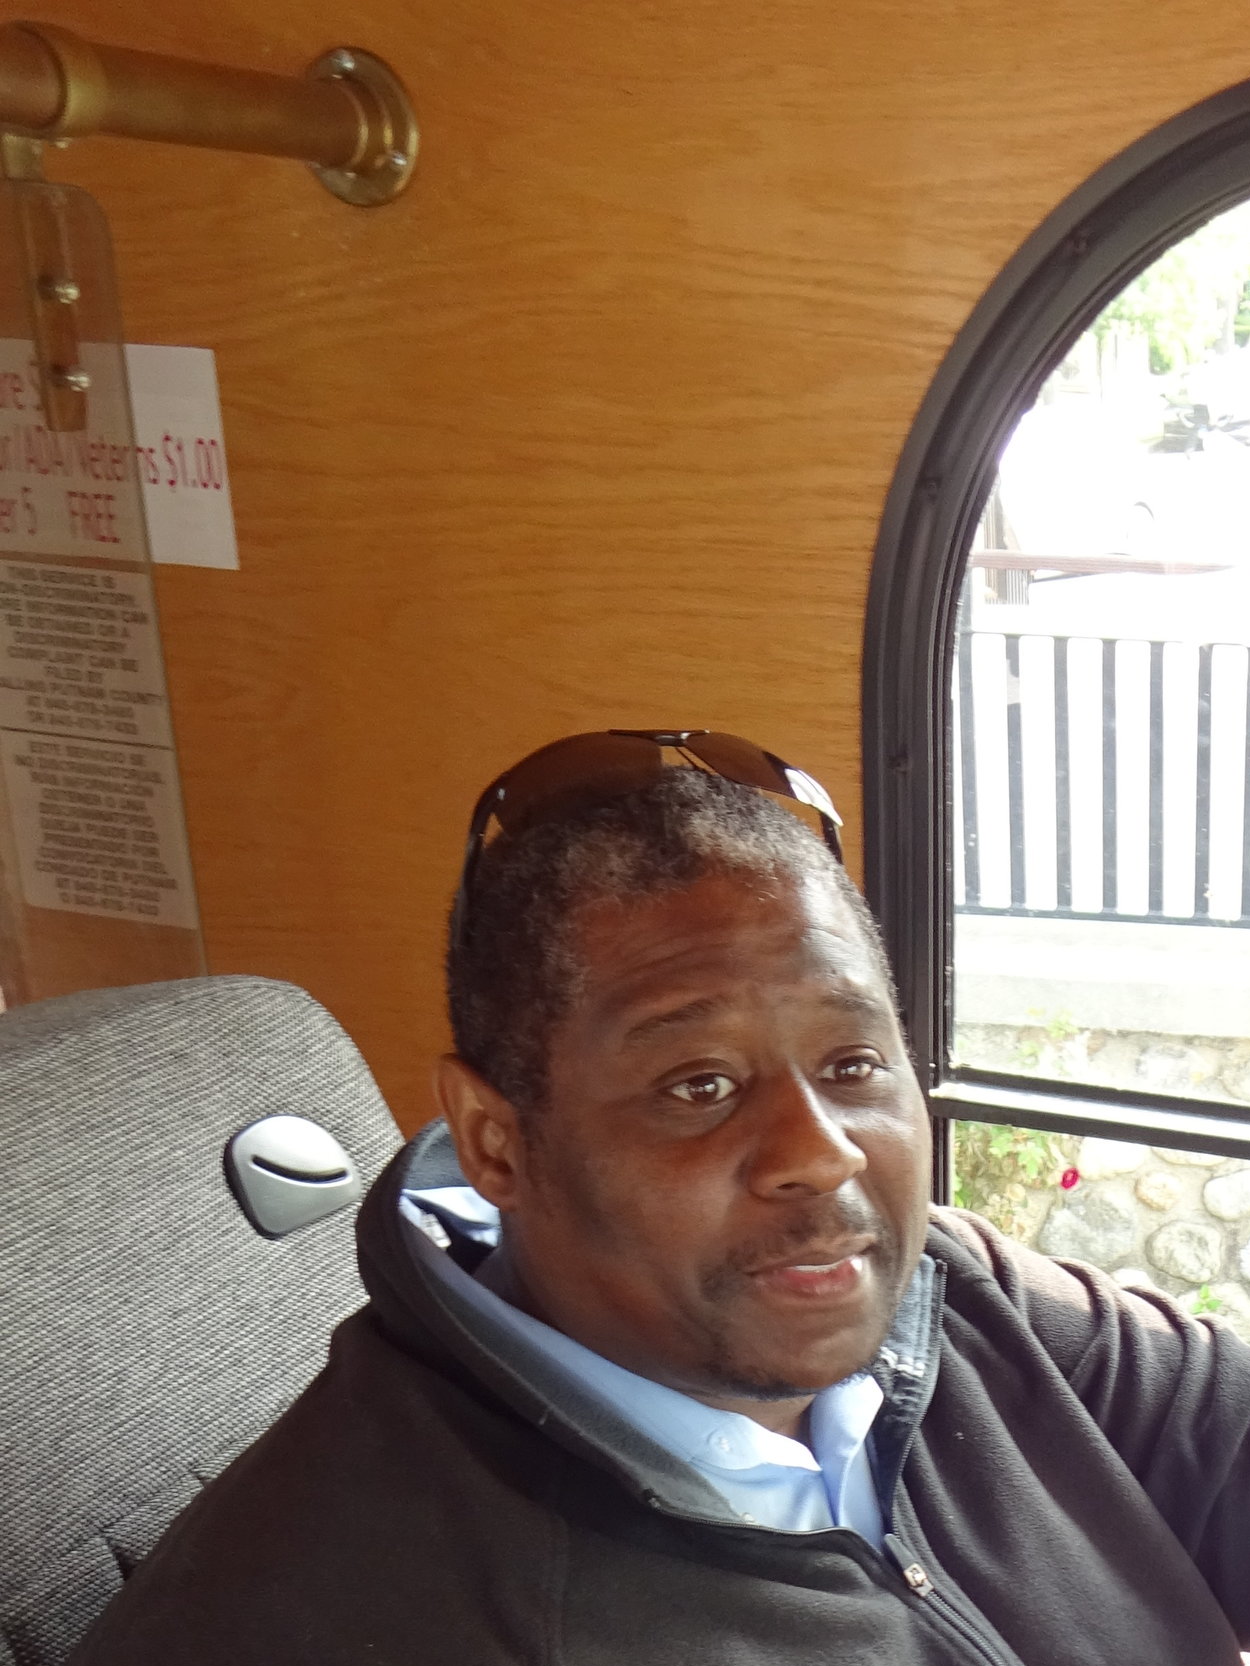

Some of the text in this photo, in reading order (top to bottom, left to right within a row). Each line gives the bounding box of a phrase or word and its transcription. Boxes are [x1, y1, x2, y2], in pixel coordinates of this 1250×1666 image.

[162, 430, 224, 492] $1.00
[20, 485, 38, 537] 5
[66, 490, 121, 543] FREE
